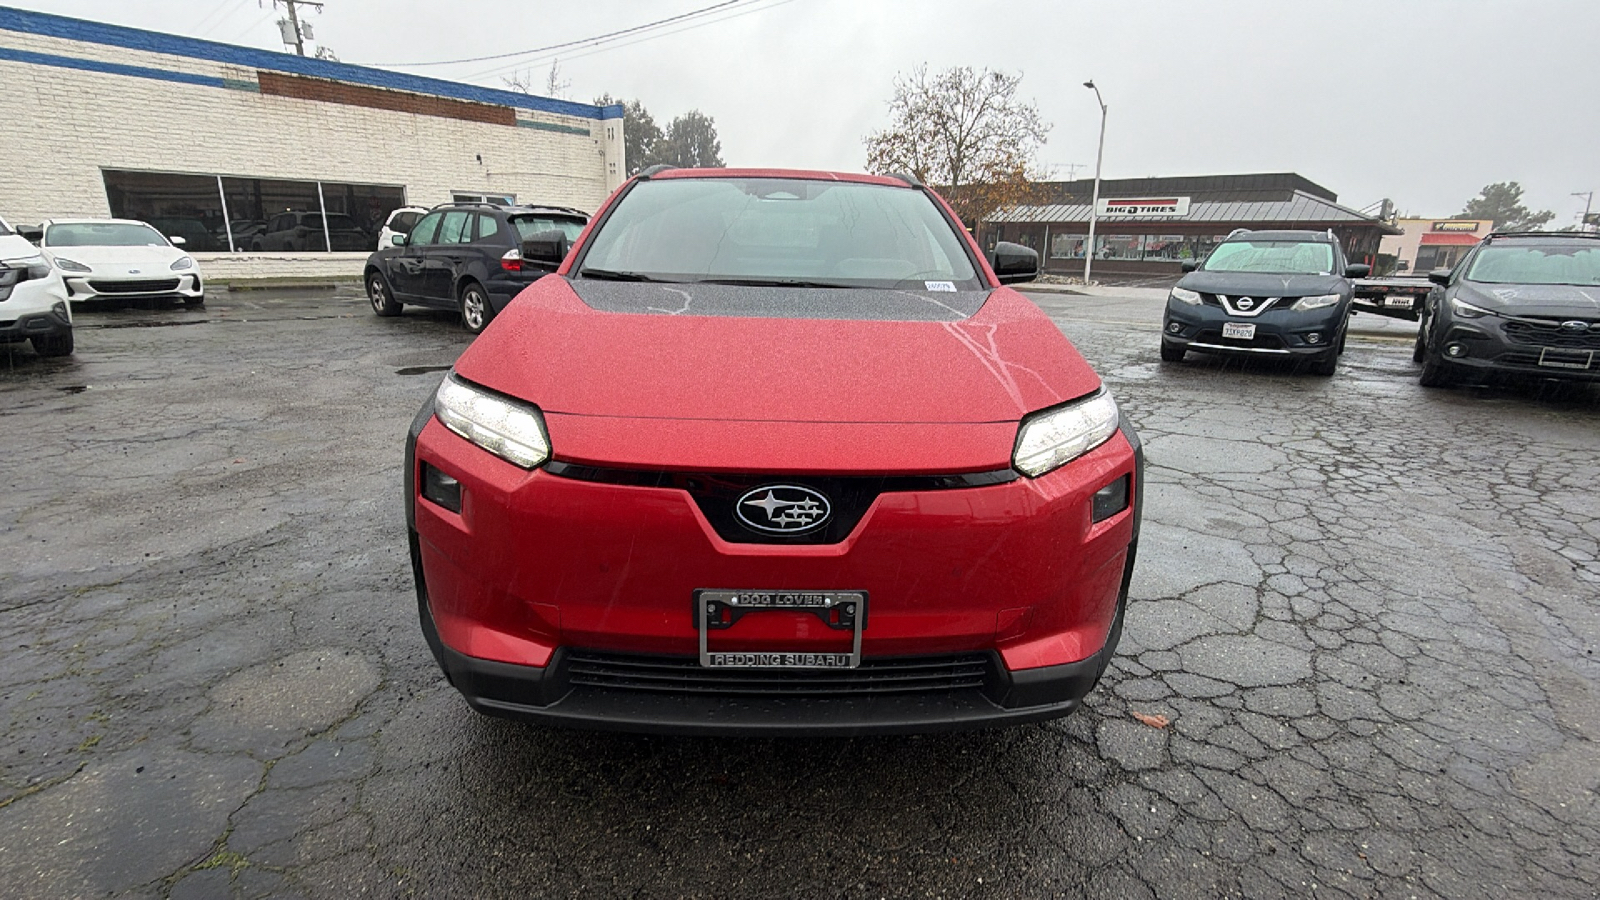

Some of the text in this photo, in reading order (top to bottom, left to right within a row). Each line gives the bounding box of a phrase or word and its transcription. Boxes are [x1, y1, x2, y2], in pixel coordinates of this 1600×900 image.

[740, 595, 823, 605] DOG LOVER
[715, 655, 846, 666] REDDING SUBARU
